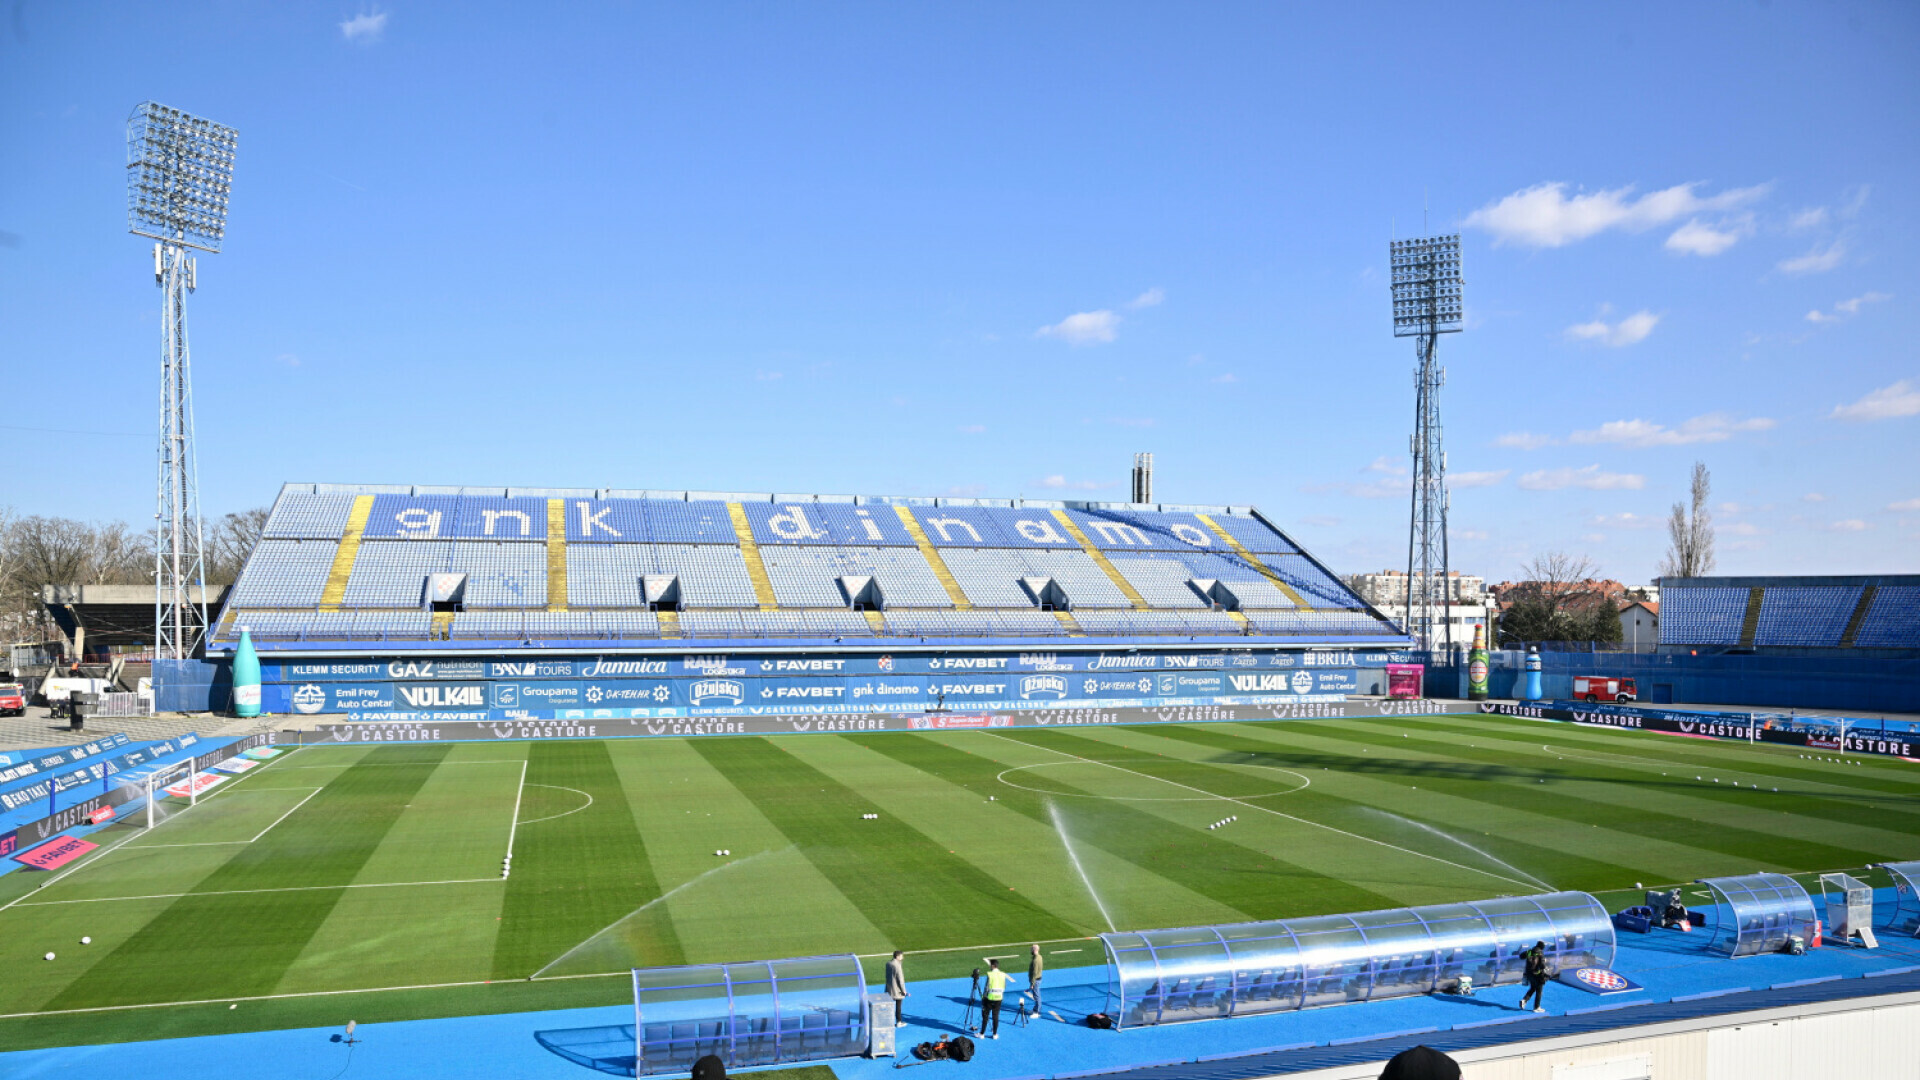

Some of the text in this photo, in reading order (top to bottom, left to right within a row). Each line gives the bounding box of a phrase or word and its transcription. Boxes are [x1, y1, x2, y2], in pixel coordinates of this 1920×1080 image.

[395, 501, 622, 540] gnk
[683, 655, 727, 669] RALU
[944, 658, 1008, 669] FAVBET
[1019, 653, 1057, 666] RALU
[1087, 652, 1156, 670] Jamnica
[1198, 658, 1225, 667] TOURS
[1232, 657, 1258, 666] Zagreb
[1270, 657, 1295, 666] Zagreb
[1317, 652, 1356, 665] BRITA
[292, 664, 380, 674] KLEMM SECURITY
[388, 660, 433, 678] GAZ
[538, 666, 572, 676] TOURS
[582, 656, 667, 678] Jamnica
[776, 659, 846, 671] FAVBET
[1024, 676, 1063, 691] Ožujsko
[1178, 676, 1221, 686] Groupama
[1319, 674, 1348, 683] Emil Frey
[336, 689, 380, 699] Emil Frey
[522, 686, 578, 698] Groupama
[694, 681, 740, 698] Ožujsko
[776, 686, 846, 698] FAVBET
[853, 682, 920, 698] gnk dinamo
[942, 684, 1006, 695] FAVBET
[337, 700, 393, 709] Auto Centar
[766, 705, 810, 713] CASTORE
[888, 703, 930, 711] CASTORE
[1397, 704, 1448, 715] CASTORE
[433, 712, 487, 720] FAVBET
[1178, 710, 1235, 721] CASTORE
[1291, 707, 1345, 718] CASTORE
[1499, 705, 1542, 718] CASTORE
[1056, 713, 1118, 724] CASTORE
[1590, 713, 1642, 728] CASTORE
[521, 725, 597, 738] CASTORE
[673, 722, 745, 735] CASTORE
[817, 719, 885, 732] CASTORE
[1699, 723, 1762, 740] CASTORE
[361, 728, 441, 741] CASTORE
[55, 798, 100, 832] CASTORE
[41, 839, 86, 862] FAVBET
